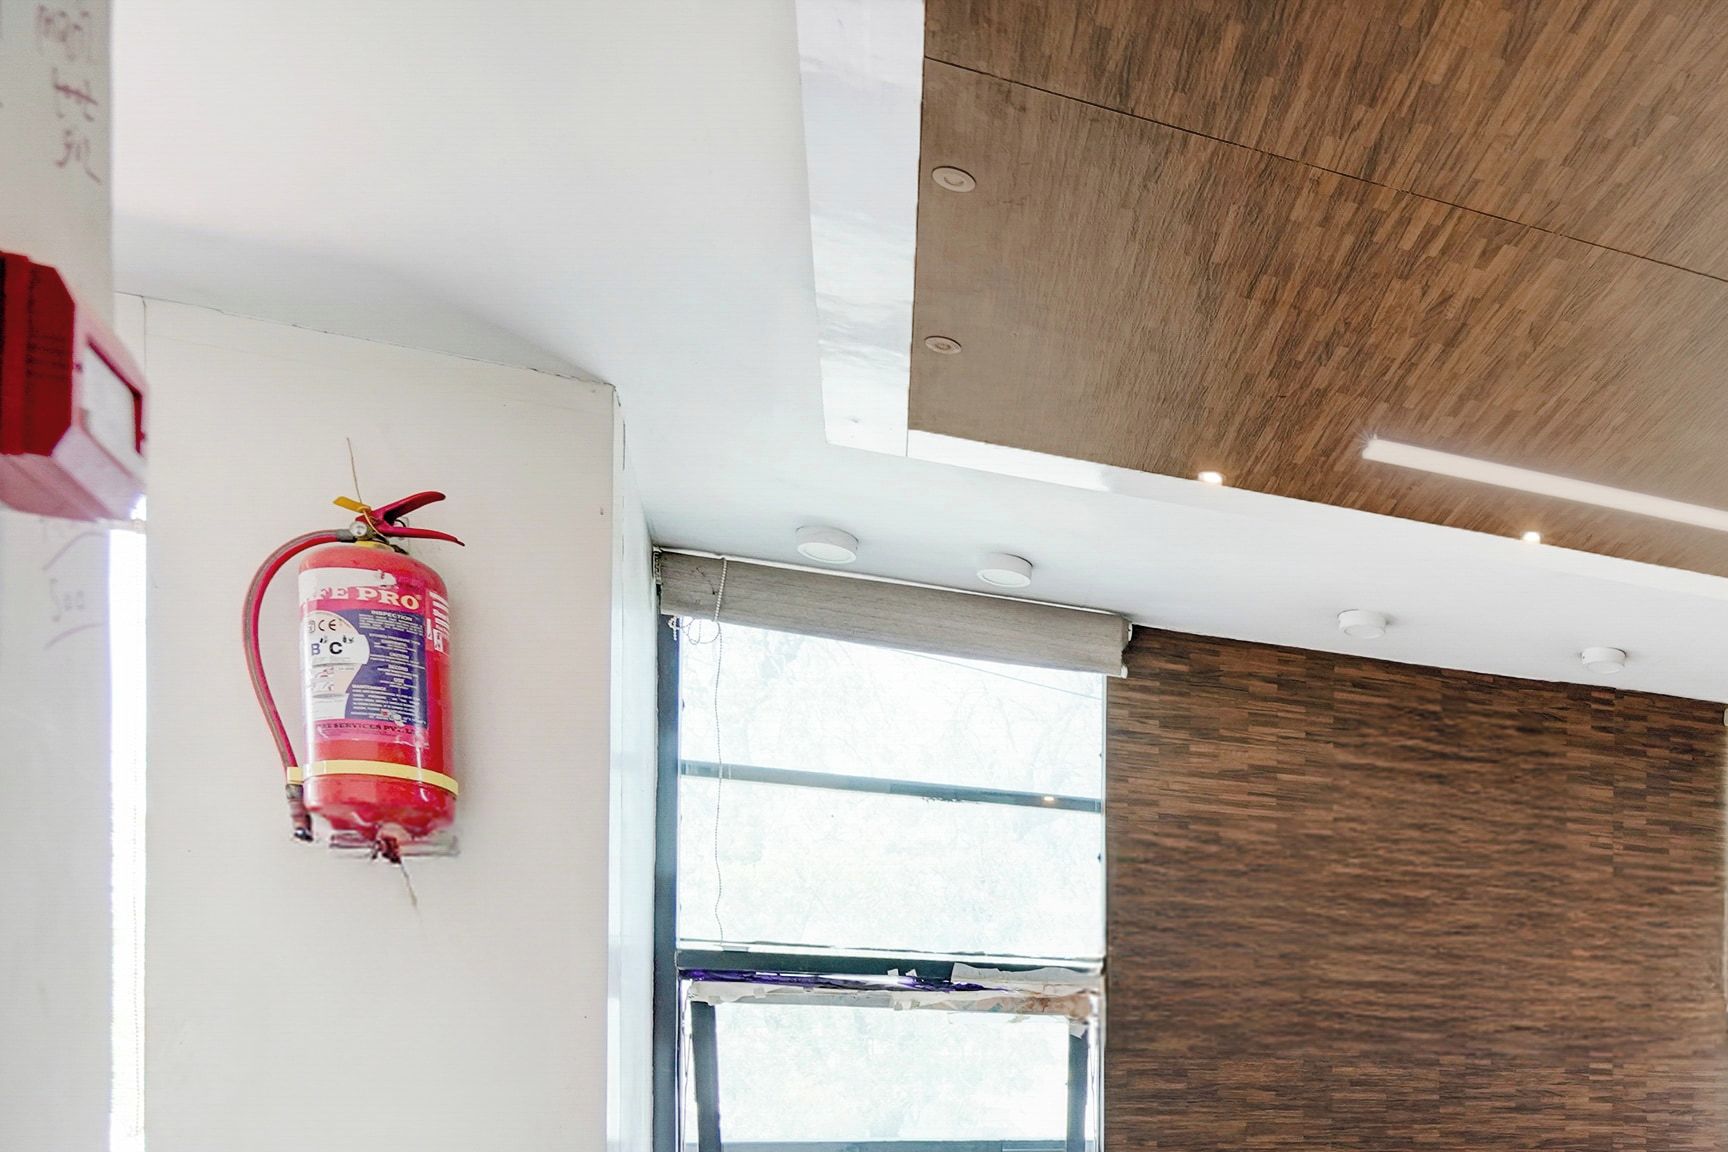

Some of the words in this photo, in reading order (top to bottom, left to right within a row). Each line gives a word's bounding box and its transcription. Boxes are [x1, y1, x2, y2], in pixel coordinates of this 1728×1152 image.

[356, 586, 420, 610] PRO
[310, 642, 321, 656] B
[328, 640, 343, 656] C
